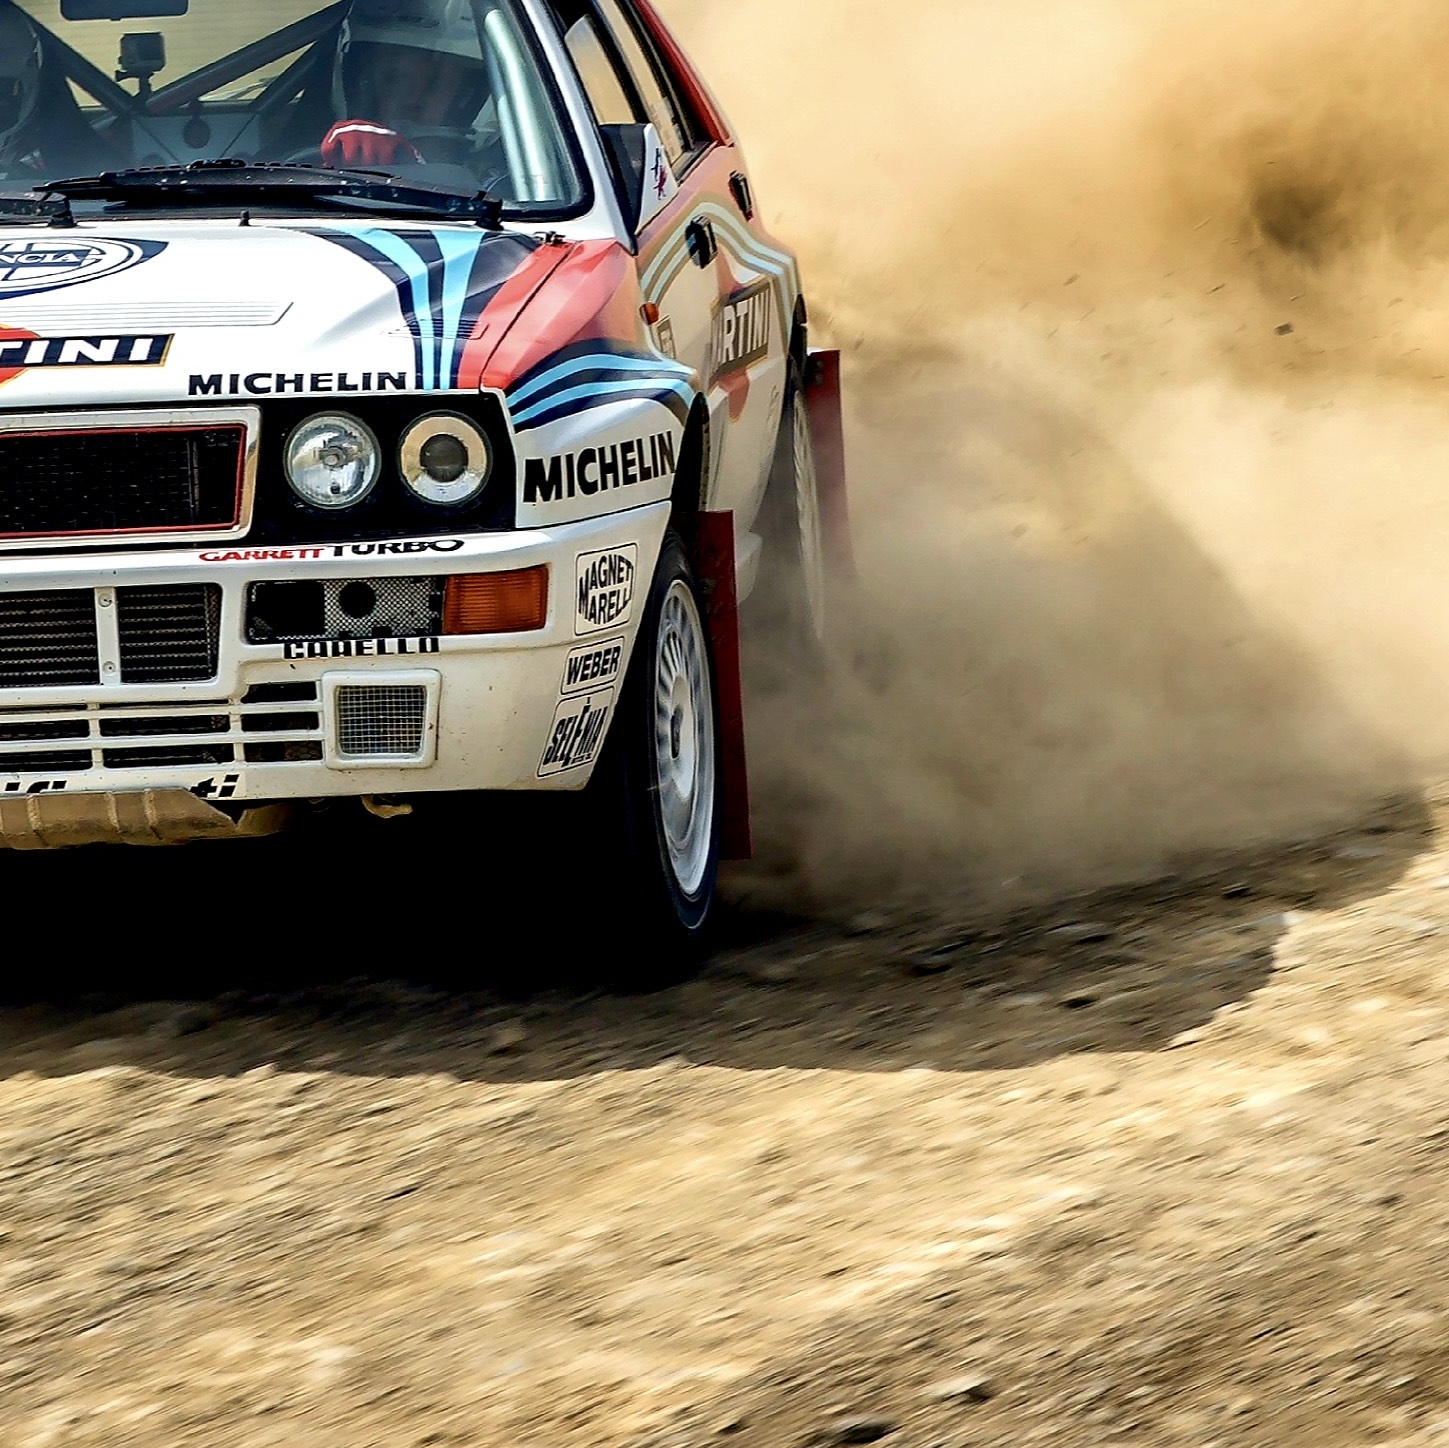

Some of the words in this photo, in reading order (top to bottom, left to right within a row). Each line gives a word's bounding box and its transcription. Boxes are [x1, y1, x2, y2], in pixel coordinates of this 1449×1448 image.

[188, 372, 407, 395] MICHELIN
[522, 430, 678, 503] MICHELIN
[199, 548, 324, 562] GARRETT
[328, 539, 464, 557] TURBO
[566, 646, 621, 686] WEBER
